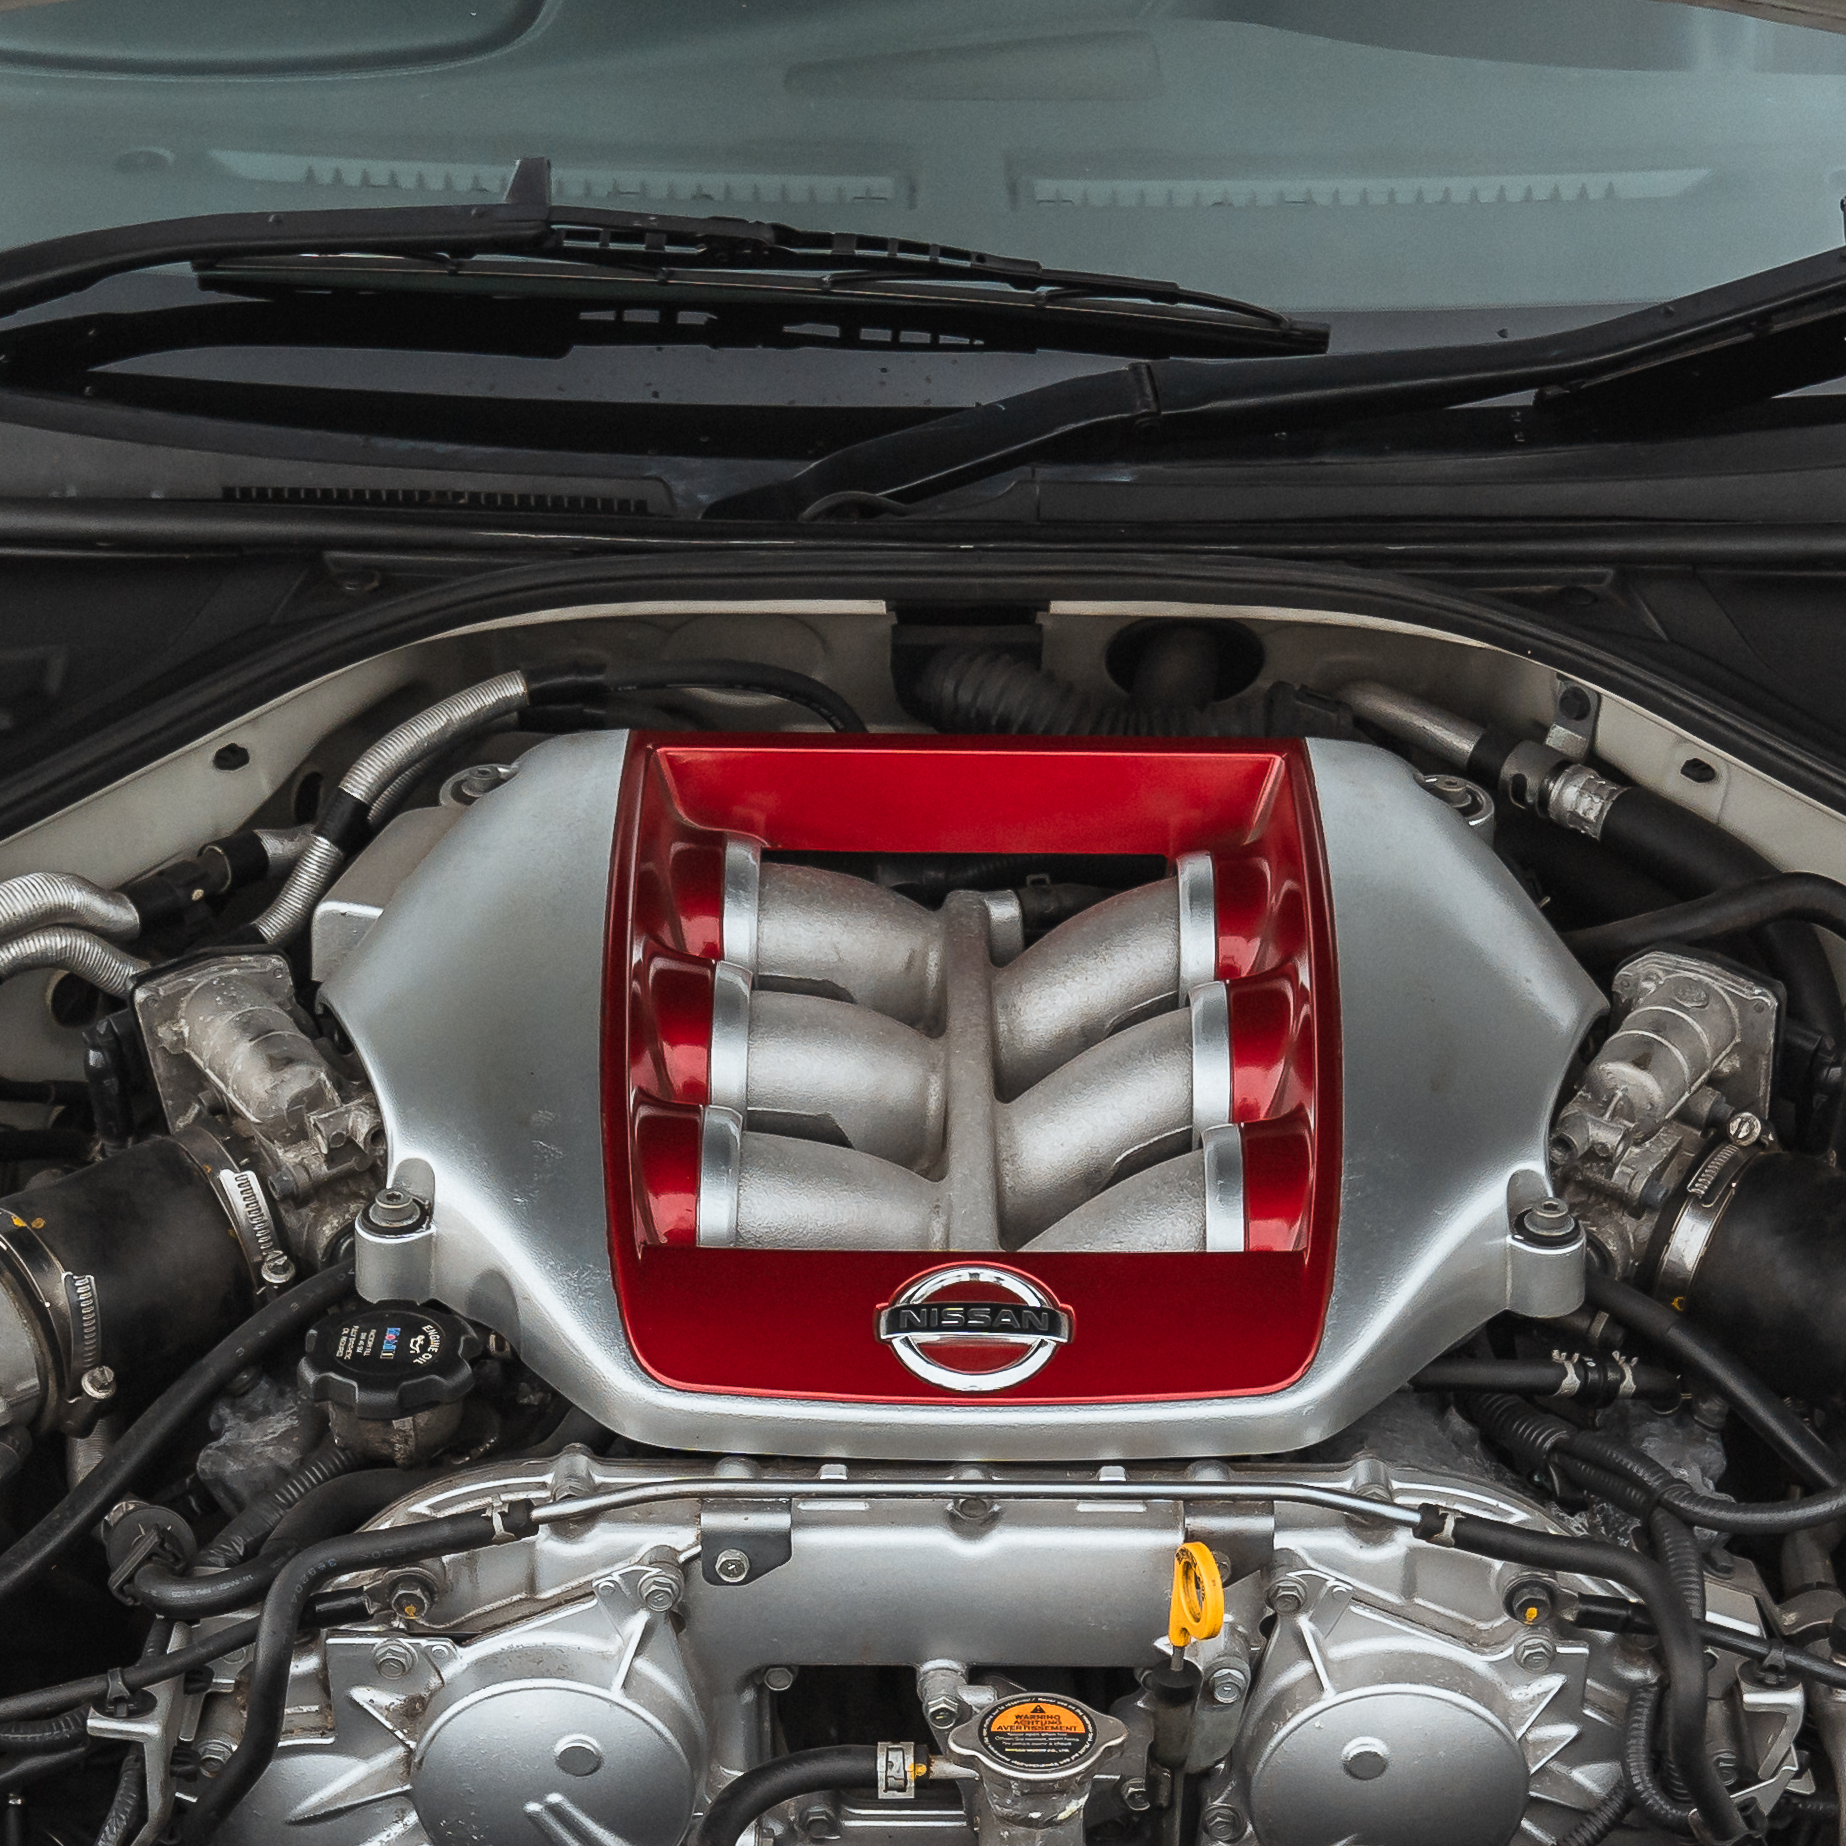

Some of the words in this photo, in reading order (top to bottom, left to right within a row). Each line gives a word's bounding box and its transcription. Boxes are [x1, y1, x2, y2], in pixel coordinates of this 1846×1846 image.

[899, 1307, 1049, 1331] NISSAN
[422, 1324, 441, 1353] ENGINE
[412, 1352, 433, 1365] OIL
